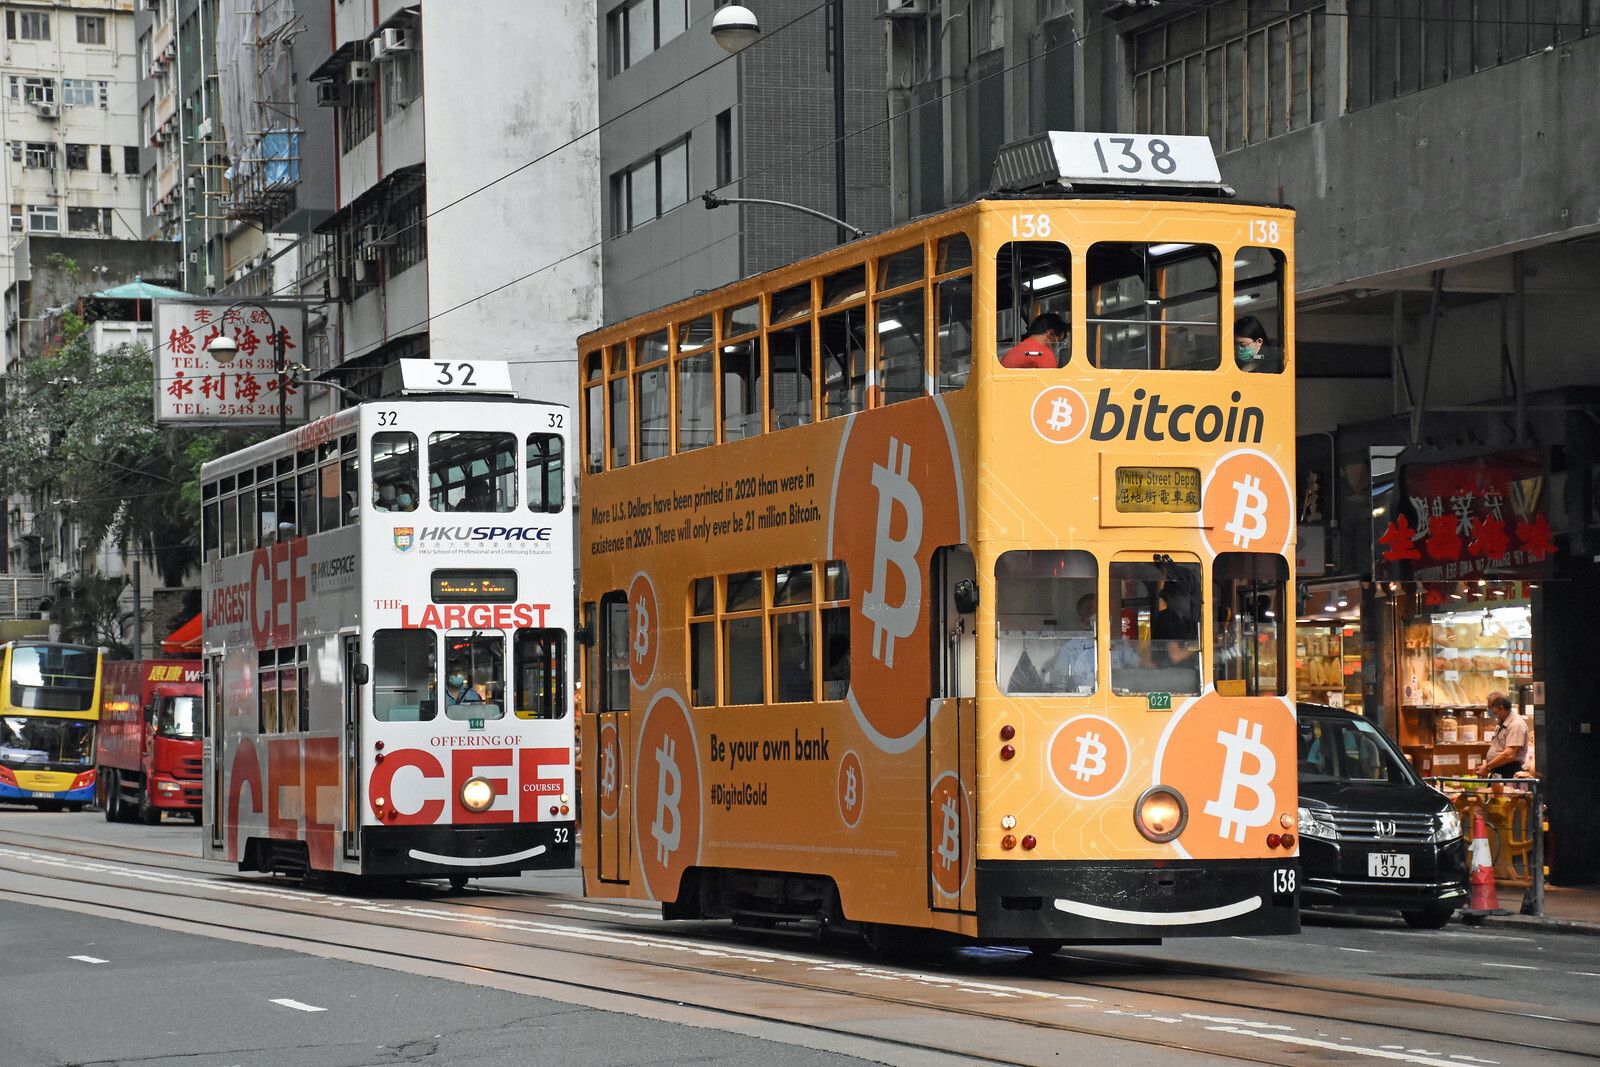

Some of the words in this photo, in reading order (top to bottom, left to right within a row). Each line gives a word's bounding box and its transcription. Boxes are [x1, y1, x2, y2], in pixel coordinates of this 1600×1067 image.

[1093, 137, 1177, 175] 138
[1011, 213, 1051, 239] 138
[1249, 219, 1279, 244] 138
[172, 357, 209, 369] TEL:
[433, 361, 478, 387] 32
[173, 403, 210, 415] TEL:
[218, 404, 254, 415] 2548
[377, 411, 398, 427] 32
[548, 413, 564, 429] 32
[1089, 387, 1265, 444] bitcoin
[1146, 471, 1171, 486] Street
[591, 507, 610, 526] More
[612, 501, 627, 522] U.S.
[628, 497, 652, 519] Dollars
[653, 494, 671, 515] have
[673, 489, 692, 511] been
[694, 481, 723, 513] printed
[725, 481, 733, 501] in
[735, 476, 756, 500] 2020
[759, 474, 778, 497] than
[780, 474, 803, 492] were
[806, 466, 815, 488] in
[591, 535, 625, 555] existence
[626, 530, 633, 550] in
[633, 527, 654, 549] 2009.
[655, 523, 676, 545] There
[677, 519, 691, 540] will
[693, 516, 711, 543] only
[713, 520, 731, 536] ever
[733, 512, 743, 533] be
[746, 510, 755, 531] 21
[758, 505, 787, 529] million
[789, 500, 821, 525] Bitcoin.
[206, 582, 250, 628] LARGEST
[373, 599, 402, 610] THE
[402, 603, 551, 630] LARGEST
[1150, 695, 1169, 706] 027
[430, 736, 500, 747] OFFERING
[504, 735, 523, 746] OF
[710, 733, 726, 762] Be
[729, 740, 759, 770] your
[762, 740, 790, 762] own
[794, 727, 829, 761] bank
[369, 747, 570, 826] CEF
[523, 783, 561, 792] COURSES
[711, 782, 768, 811] #DigitalGold
[554, 828, 569, 844] 32
[1374, 865, 1407, 877] 1370
[1380, 854, 1398, 866] WT
[1273, 868, 1296, 893] 138
